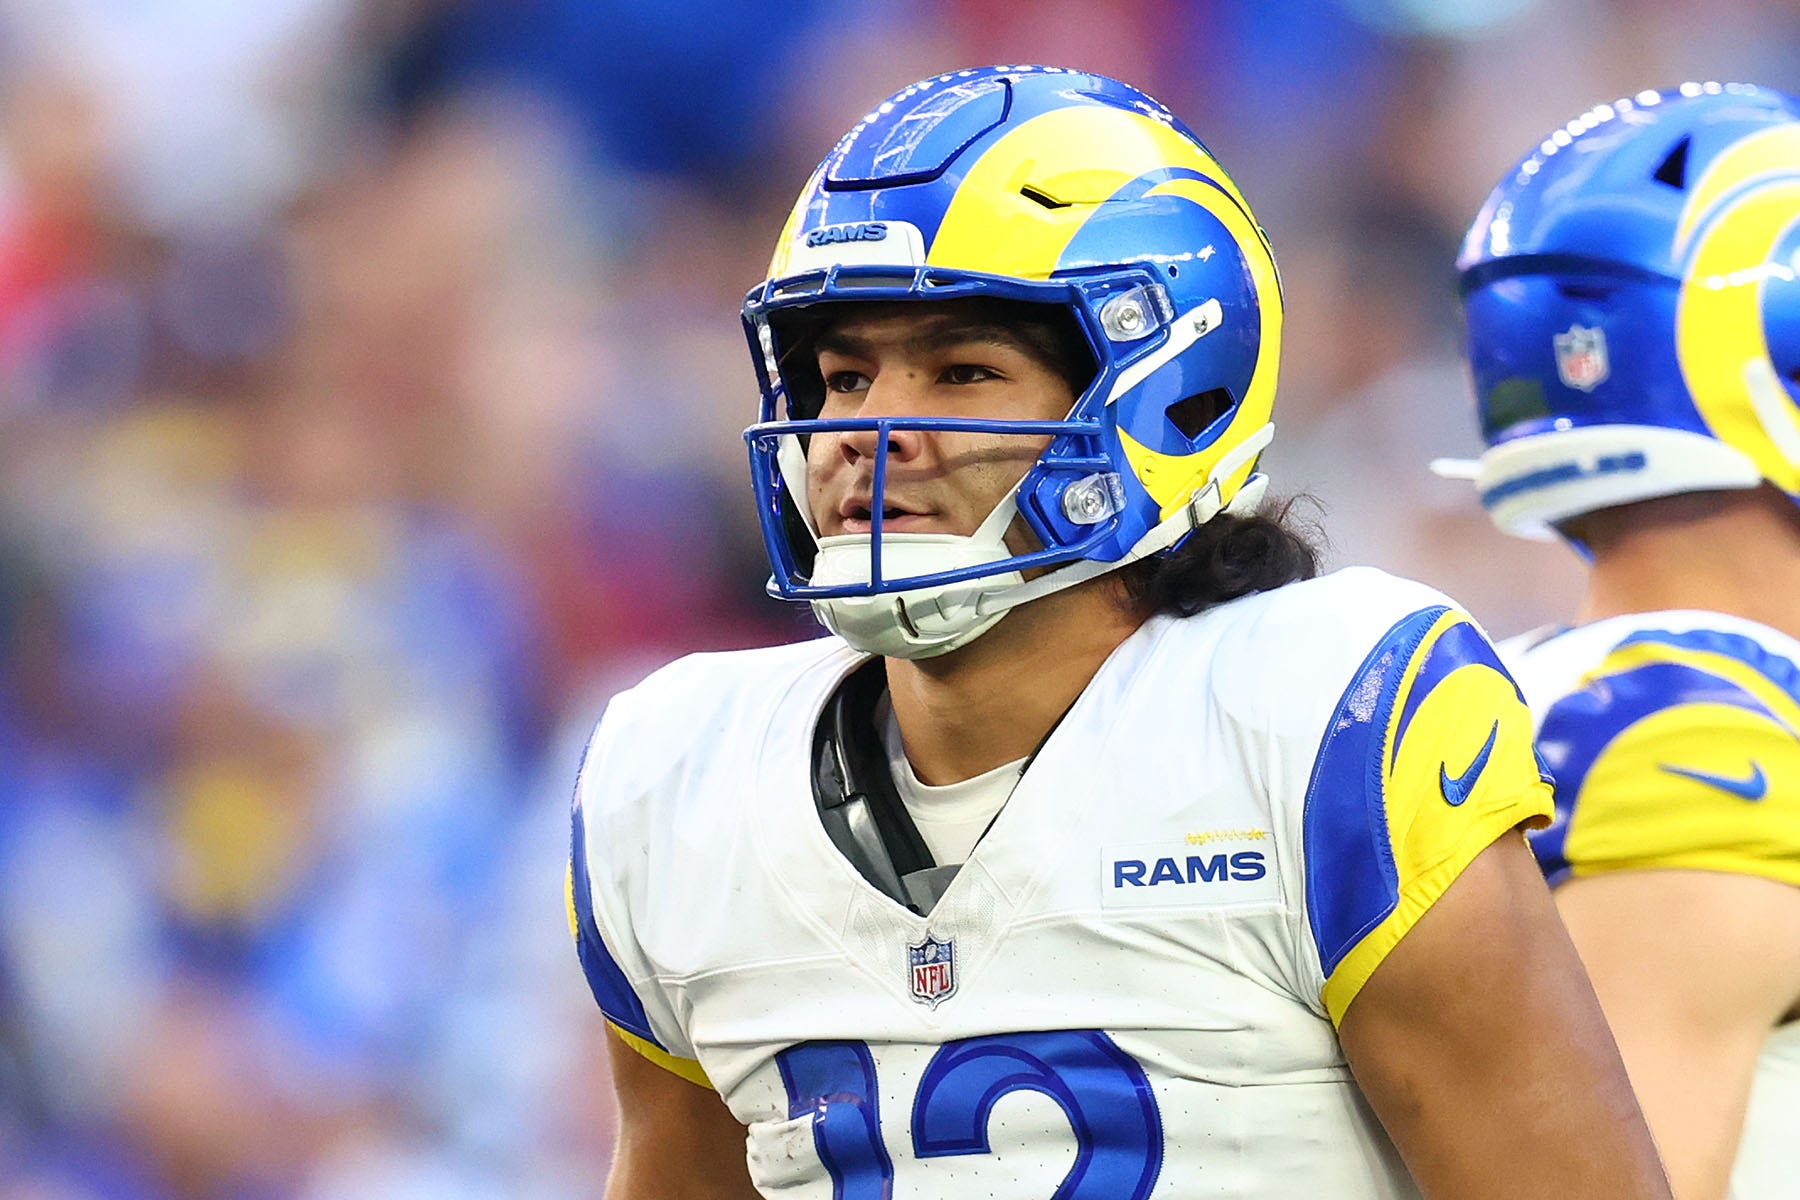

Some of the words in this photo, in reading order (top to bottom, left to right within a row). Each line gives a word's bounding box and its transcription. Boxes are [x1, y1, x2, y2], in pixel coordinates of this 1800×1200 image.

[806, 223, 888, 248] RAMS
[1113, 851, 1267, 888] RAMS
[915, 964, 950, 995] NFL
